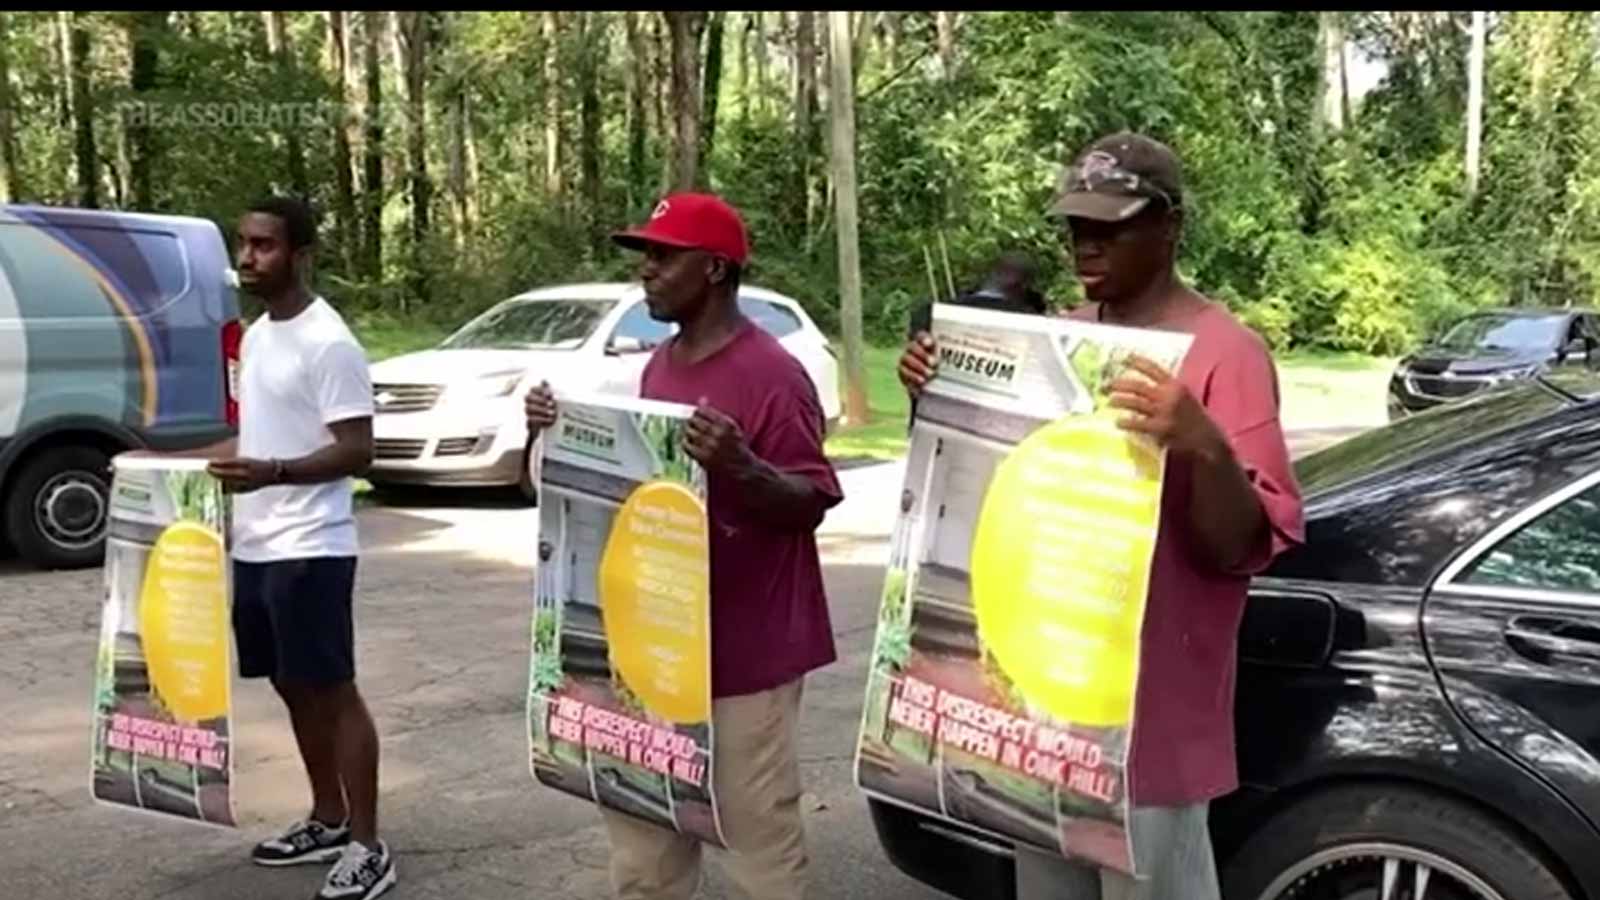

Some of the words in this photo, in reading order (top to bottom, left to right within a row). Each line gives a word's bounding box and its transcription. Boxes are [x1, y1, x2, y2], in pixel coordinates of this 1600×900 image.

[940, 346, 1016, 382] MUSEUM
[562, 424, 616, 447] MUSEUM
[549, 715, 583, 743] NEVER
[585, 724, 627, 762] HAPPEN
[628, 741, 643, 765] IN
[643, 748, 671, 775] OAK
[584, 704, 652, 745] DISRESPECT
[652, 727, 697, 759] WOULD
[889, 697, 936, 736] NEVER
[937, 716, 1000, 761] HAPPEN
[1001, 741, 1024, 769] IN
[1024, 751, 1066, 785] OAK
[891, 675, 936, 708] THIS
[936, 690, 1035, 744] DISRESPECT
[1036, 726, 1102, 768] WOULD
